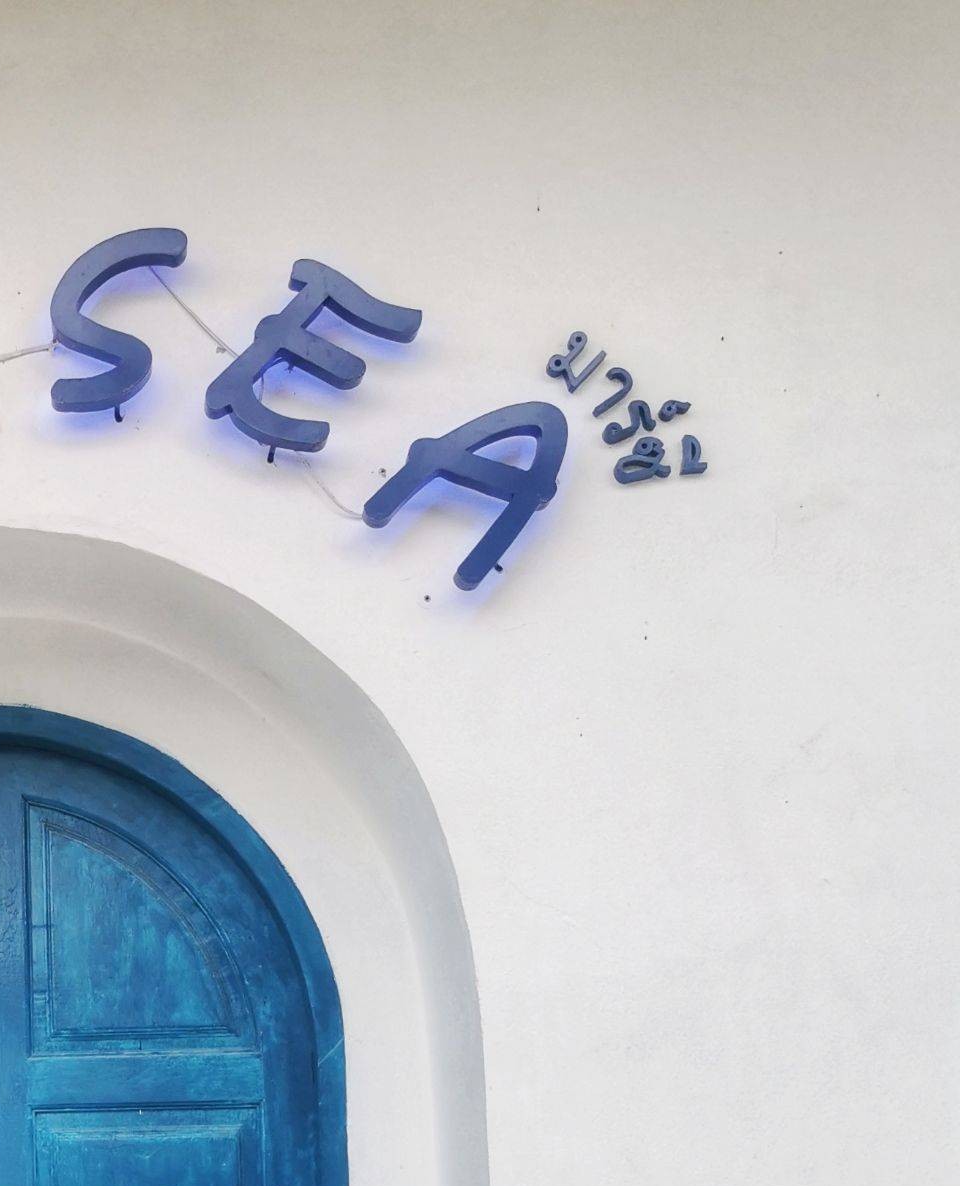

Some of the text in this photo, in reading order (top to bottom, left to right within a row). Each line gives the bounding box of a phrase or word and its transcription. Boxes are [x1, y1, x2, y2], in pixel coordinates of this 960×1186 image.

[50, 228, 568, 591] SEA
[546, 331, 708, 484] มาร์ซี
